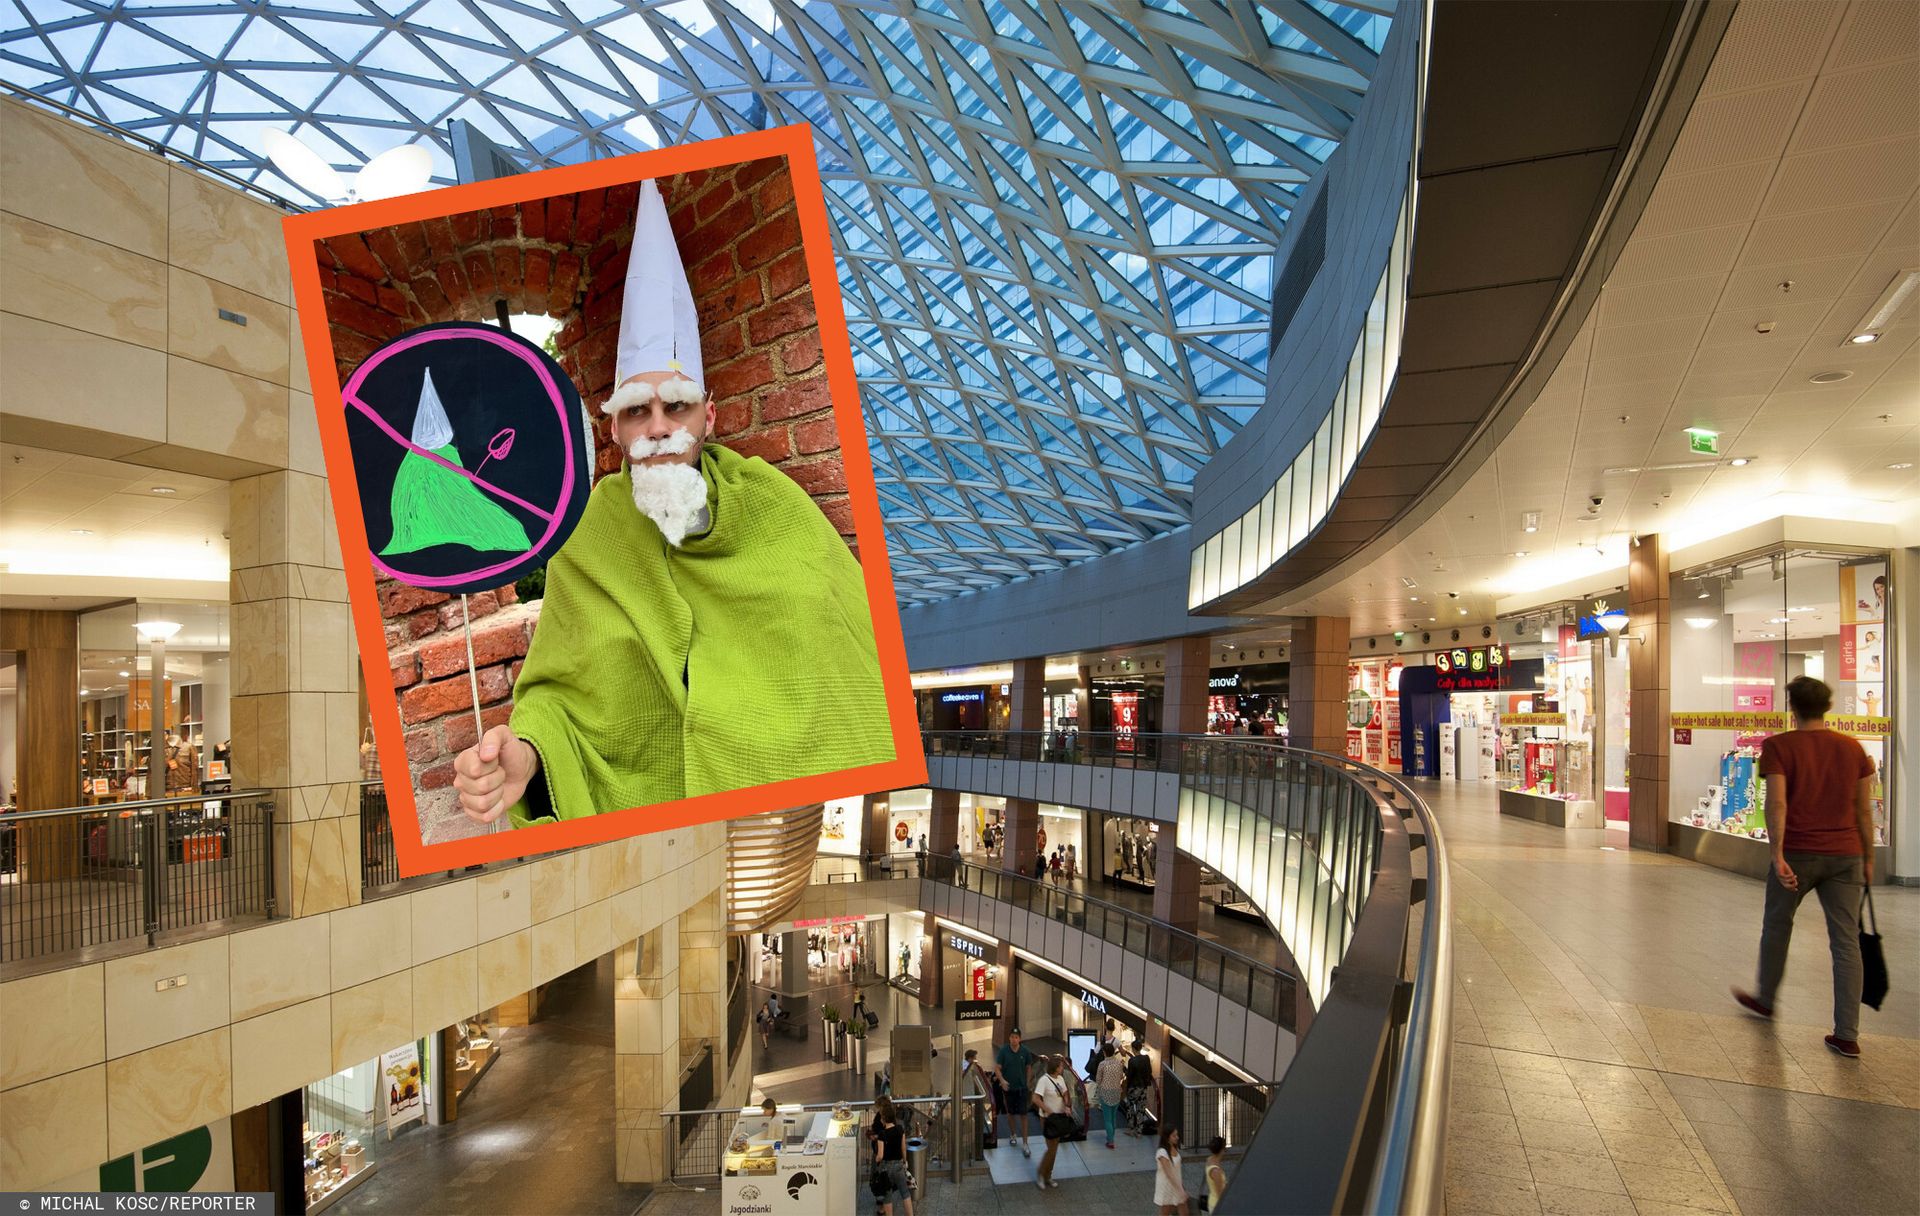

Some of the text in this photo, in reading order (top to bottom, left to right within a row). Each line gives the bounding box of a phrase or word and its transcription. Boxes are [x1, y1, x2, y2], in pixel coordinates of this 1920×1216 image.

[1843, 640, 1855, 664] girls
[1844, 696, 1855, 714] oys
[1671, 714, 1681, 726] hot
[1682, 715, 1693, 727] sale
[1696, 715, 1708, 727] hot
[1708, 715, 1721, 727] sale
[1723, 715, 1735, 728] hot
[1735, 715, 1749, 728] sale
[1754, 715, 1767, 728] hot
[1768, 715, 1783, 729] sale
[1837, 717, 1854, 731] hot
[1857, 720, 1877, 732] sale
[951, 935, 984, 958] ESPRIT
[977, 975, 985, 998] sale
[1081, 989, 1106, 1014] ZARA
[960, 1010, 990, 1019] poziom
[730, 1205, 772, 1216] Jagodzianki
